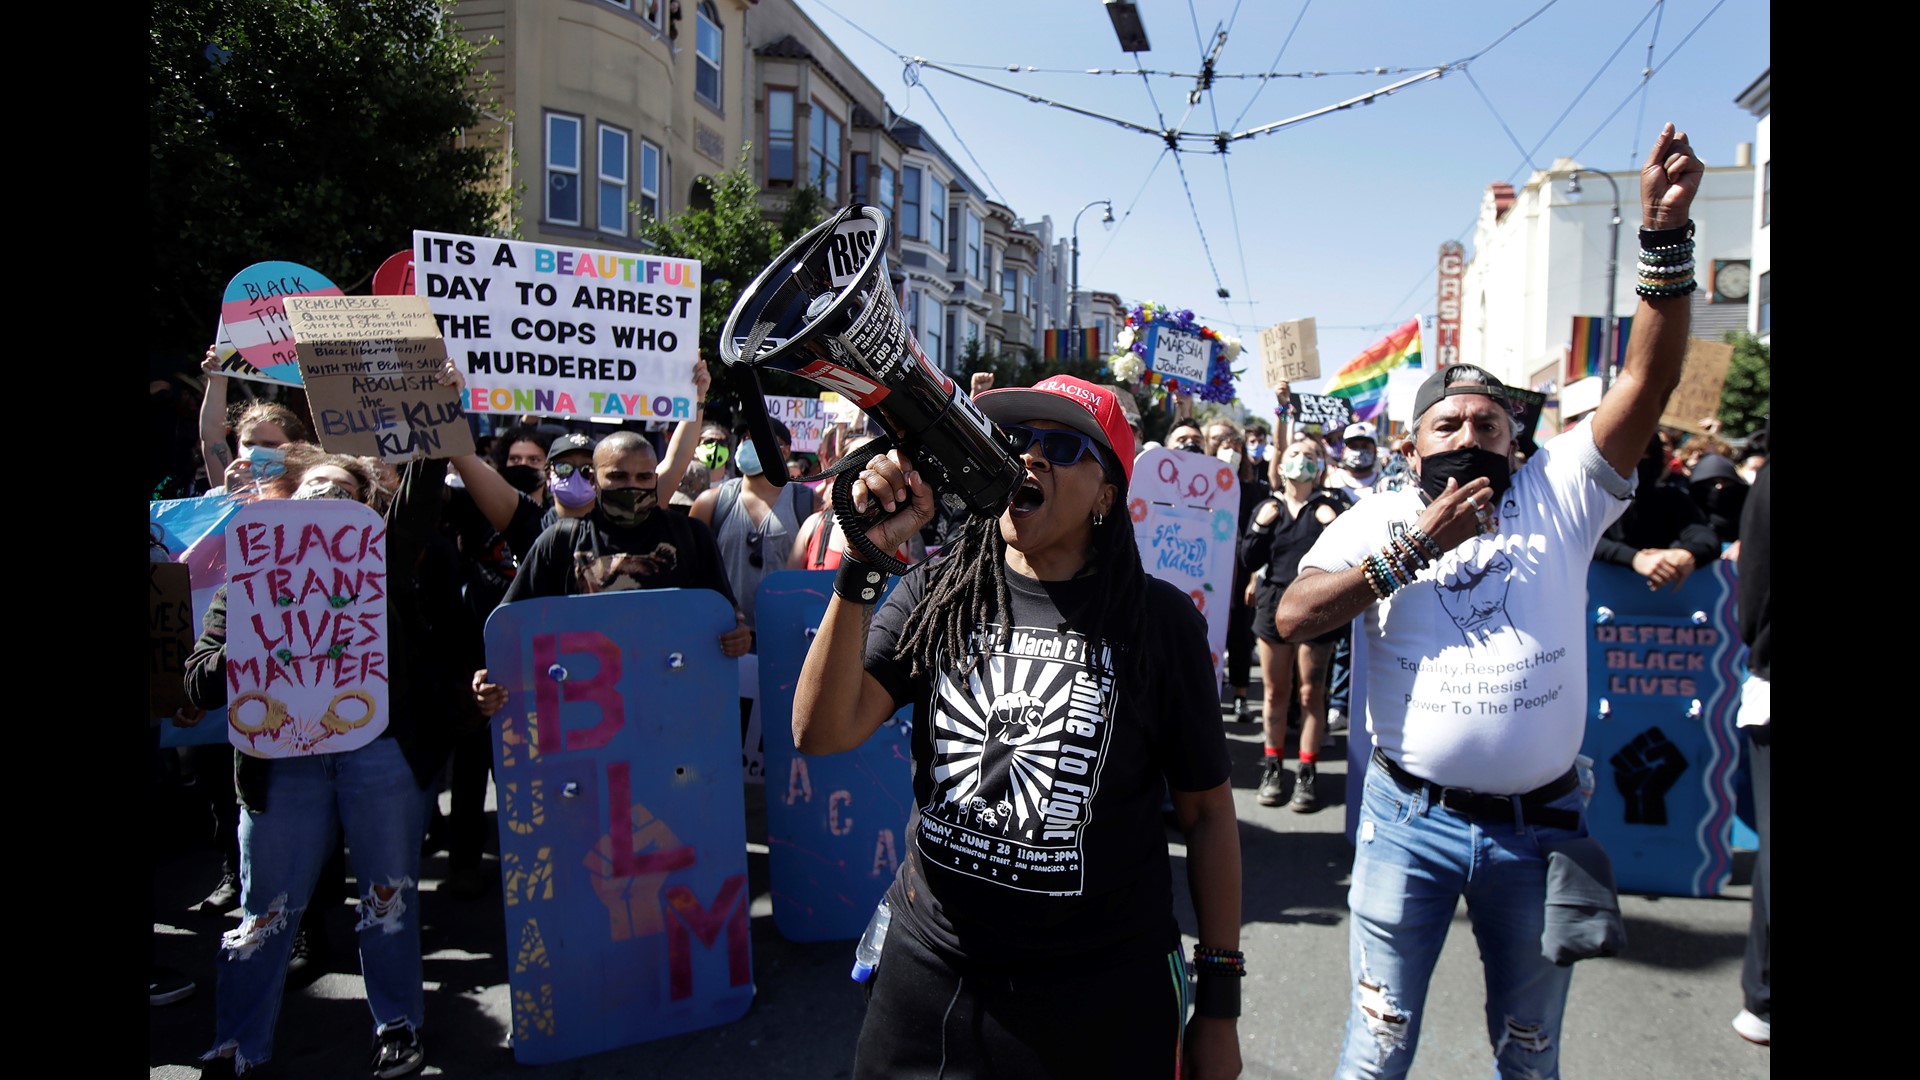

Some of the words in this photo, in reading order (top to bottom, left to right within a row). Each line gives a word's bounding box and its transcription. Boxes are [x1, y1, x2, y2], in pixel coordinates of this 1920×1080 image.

[422, 237, 476, 266] ITS
[492, 243, 517, 268] A
[535, 248, 696, 288] BEAUTIFUL
[242, 276, 310, 306] BLACK
[293, 298, 389, 311] REMEMBER:
[426, 273, 491, 301] DAY
[515, 281, 558, 307] TO
[571, 285, 693, 318] ARREST
[302, 311, 341, 322] Queer
[346, 312, 381, 323] people
[386, 311, 397, 320] of
[401, 312, 428, 320] color
[1439, 254, 1461, 366] CASTR
[303, 319, 354, 330] started
[434, 314, 492, 339] THE
[510, 317, 597, 346] COPS
[611, 325, 678, 352] WHO
[860, 320, 883, 350] Streets
[315, 347, 348, 357] Black
[872, 341, 891, 365] GO!
[1156, 335, 1204, 360] MARSHA
[1267, 342, 1298, 364] LIES
[306, 363, 340, 375] WITH
[343, 361, 373, 373] THAT
[377, 360, 413, 372] BEING
[467, 351, 637, 381] MURDERED
[1156, 357, 1203, 381] JOHNSON
[1266, 361, 1309, 384] MTER
[352, 374, 434, 394] ABOLISH
[1047, 381, 1102, 406] RACISM
[359, 396, 386, 409] the
[460, 388, 576, 414] REONNA
[589, 391, 690, 418] TAYLOR
[786, 399, 824, 420] PRIDE
[1299, 393, 1344, 407] BLACK
[320, 407, 399, 436] BLUE
[401, 397, 468, 431] KLUX
[375, 428, 442, 457] KLAN
[236, 522, 387, 566] BLACK
[1153, 523, 1182, 548] SAY
[1156, 549, 1206, 578] NAMES
[231, 567, 388, 607] TRANS
[251, 609, 384, 652] LIVES
[1595, 624, 1718, 646] DEFEND
[1009, 631, 1060, 659] March
[227, 651, 389, 694] MATTER
[1605, 649, 1705, 672] BLACK
[1440, 681, 1472, 695] And
[1478, 677, 1528, 694] Resist
[1608, 674, 1697, 697] LIVES
[1063, 671, 1113, 738] Unite
[1404, 693, 1447, 714] Power
[1452, 701, 1473, 716] To
[1477, 701, 1508, 715] The
[1055, 743, 1098, 776] to
[532, 630, 752, 1001] BLM
[1039, 779, 1092, 841] Fight
[950, 842, 987, 860] WASHINGTON
[1014, 861, 1028, 870] SAN
[1069, 863, 1079, 871] CA
[960, 832, 991, 851] JUNE
[997, 843, 1011, 856] 28
[1017, 847, 1079, 863] 11AM-3PM
[502, 711, 555, 1041] HUMAN
